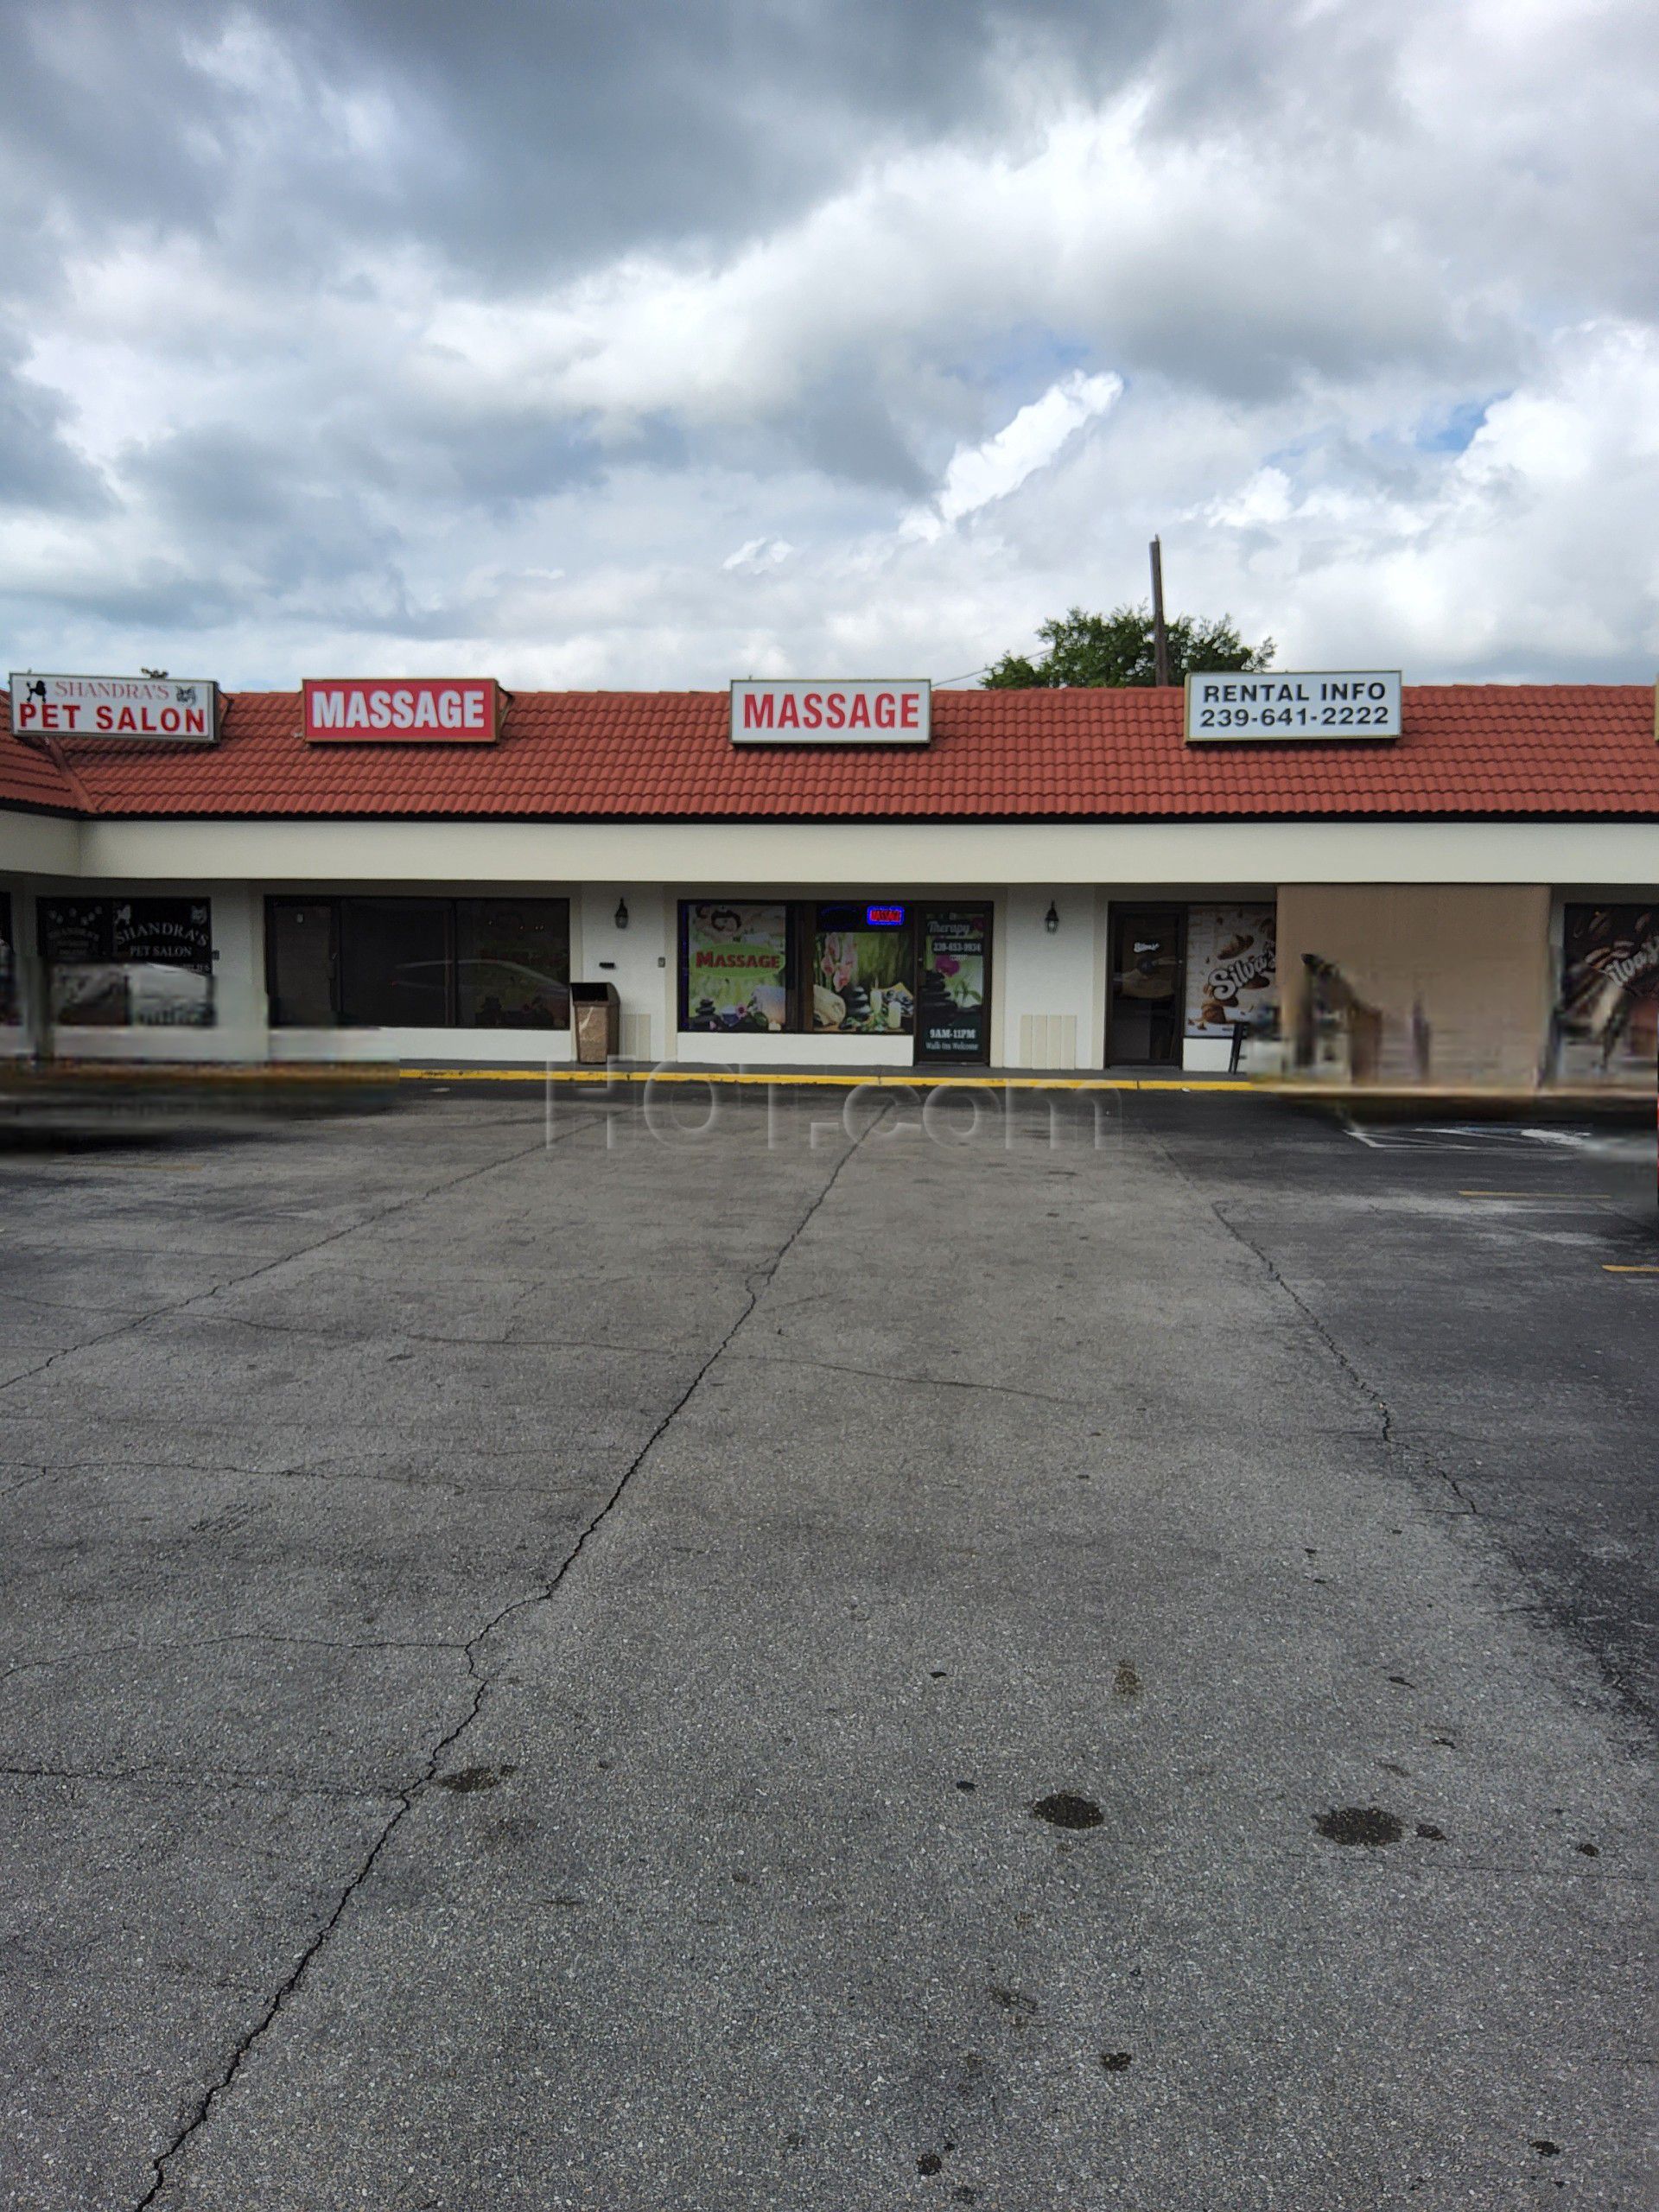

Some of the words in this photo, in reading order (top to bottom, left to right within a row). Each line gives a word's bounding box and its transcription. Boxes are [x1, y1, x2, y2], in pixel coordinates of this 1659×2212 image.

[54, 680, 170, 701] SHANDRA'S
[1204, 683, 1309, 702] RENTAL
[1320, 682, 1386, 701] INFO
[19, 703, 80, 728] PET
[96, 705, 205, 733] SALON
[312, 690, 485, 729] MASSAGE
[743, 693, 919, 729] MASSAGE
[1200, 707, 1389, 728] 239-641-2222
[116, 922, 209, 947] SHANDRA'S
[152, 945, 193, 957] SALON
[696, 950, 780, 969] MASSAGE
